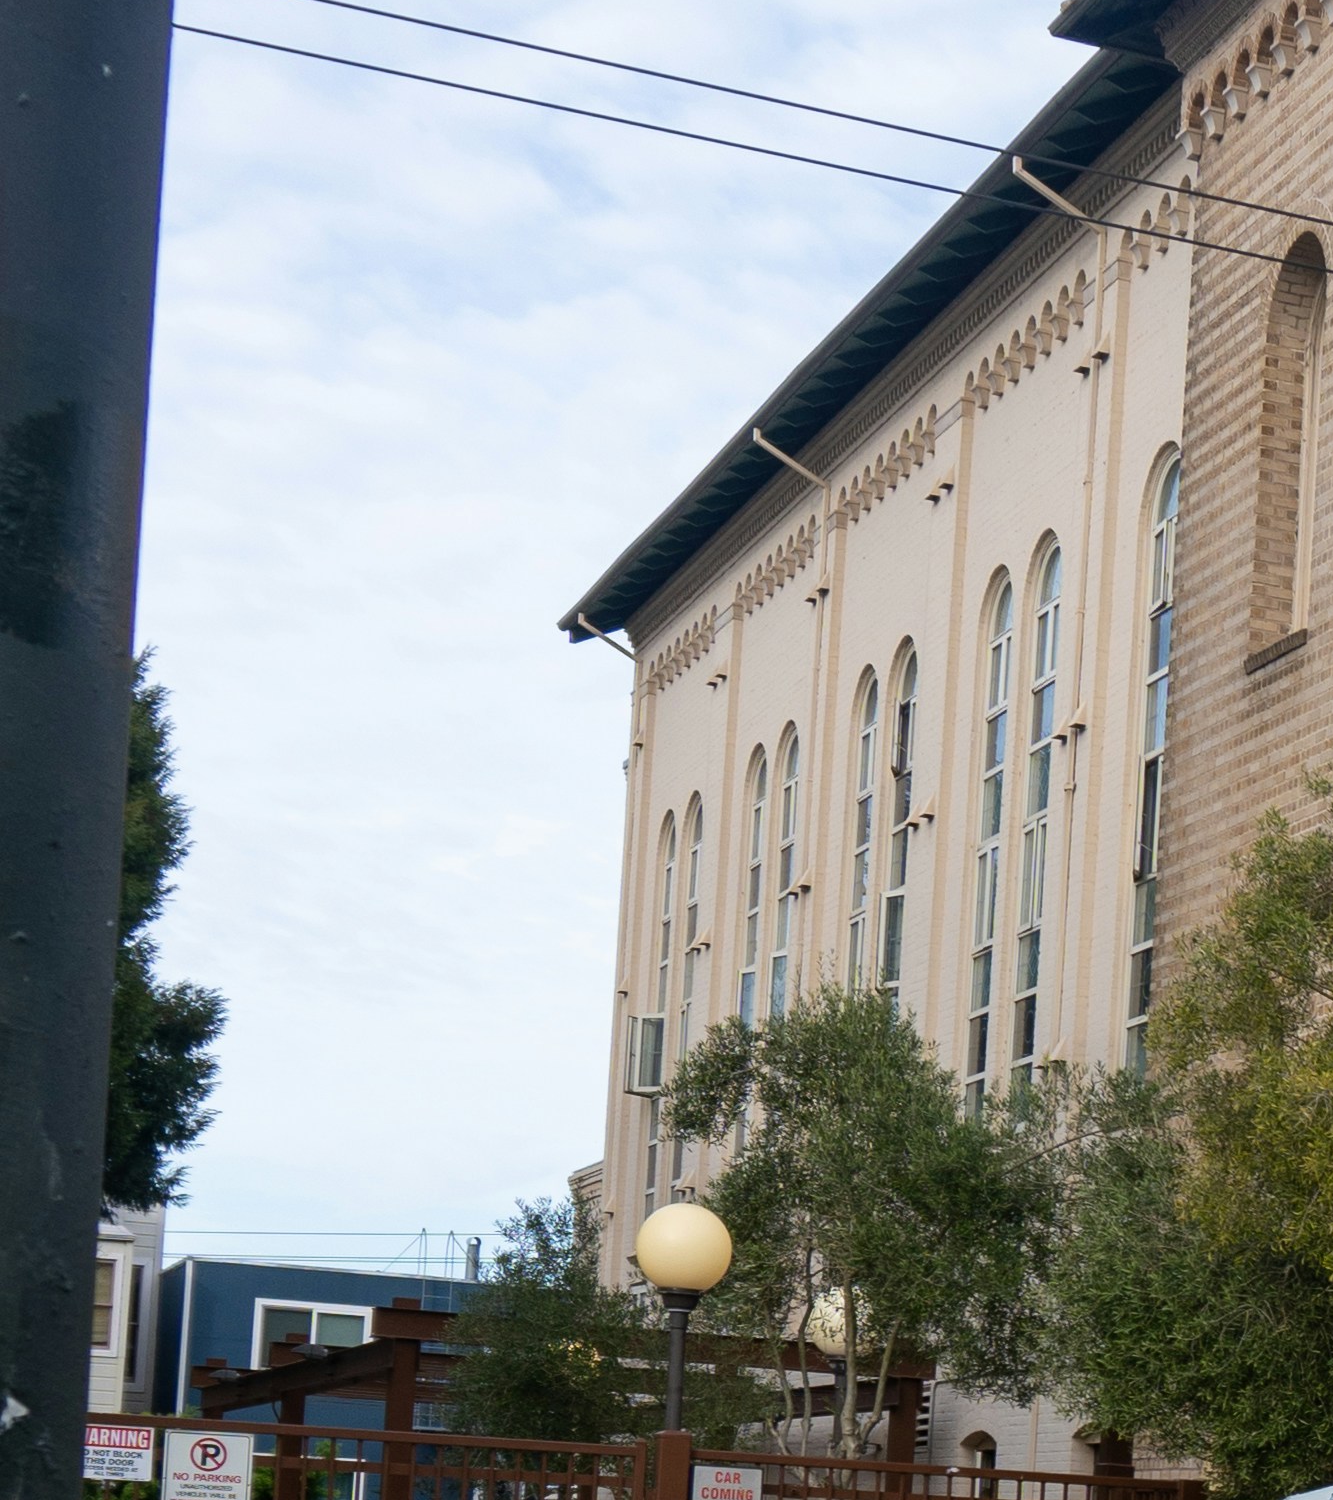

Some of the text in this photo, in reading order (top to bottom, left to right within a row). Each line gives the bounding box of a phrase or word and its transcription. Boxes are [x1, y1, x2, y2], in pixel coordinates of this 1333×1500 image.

[85, 1427, 149, 1448] ARNING
[113, 1450, 143, 1458] BLOCK
[108, 1458, 134, 1466] DOOR
[172, 1472, 242, 1484] NO PARKING
[715, 1471, 742, 1484] CAR
